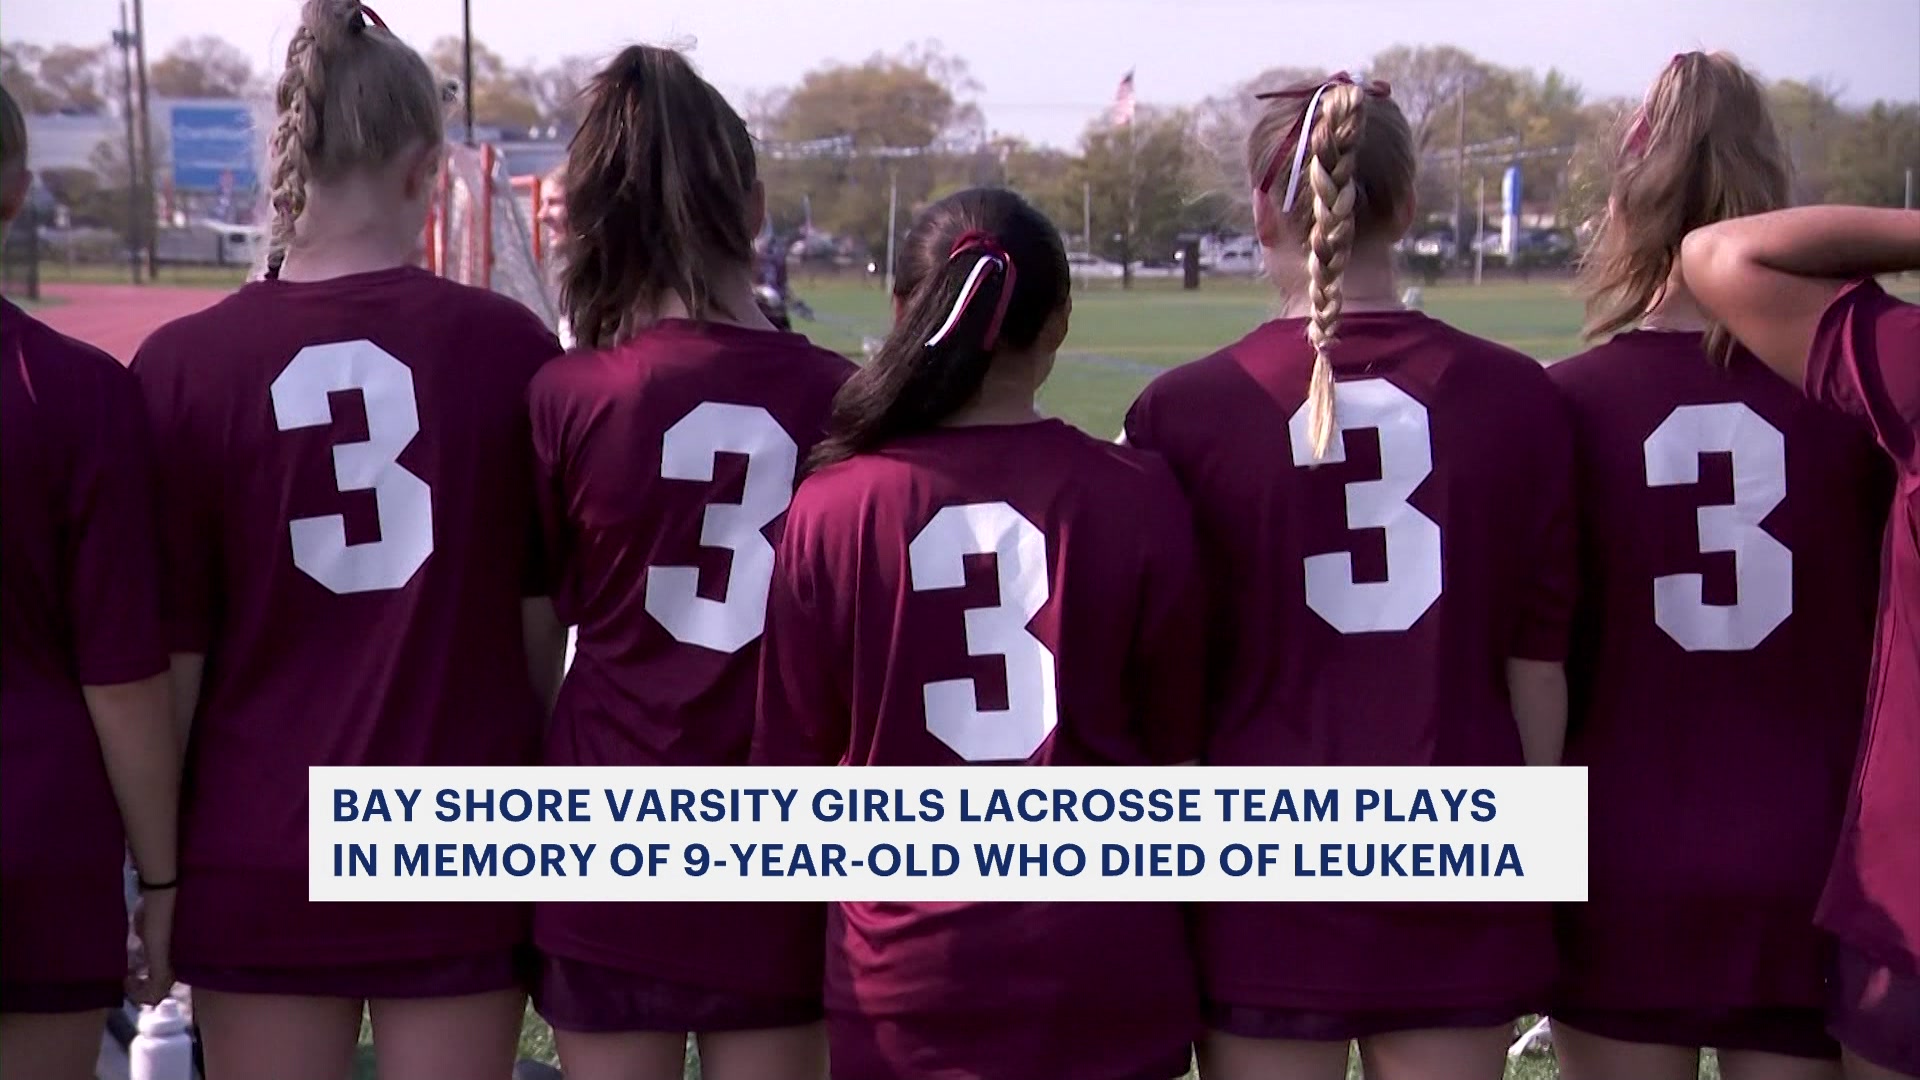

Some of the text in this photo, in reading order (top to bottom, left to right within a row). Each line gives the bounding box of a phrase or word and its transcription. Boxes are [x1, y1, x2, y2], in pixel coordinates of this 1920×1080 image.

[270, 338, 434, 594] 3
[645, 401, 798, 653] 3
[1288, 378, 1443, 634] 3
[1644, 402, 1793, 651] 3
[909, 501, 1056, 761] 3
